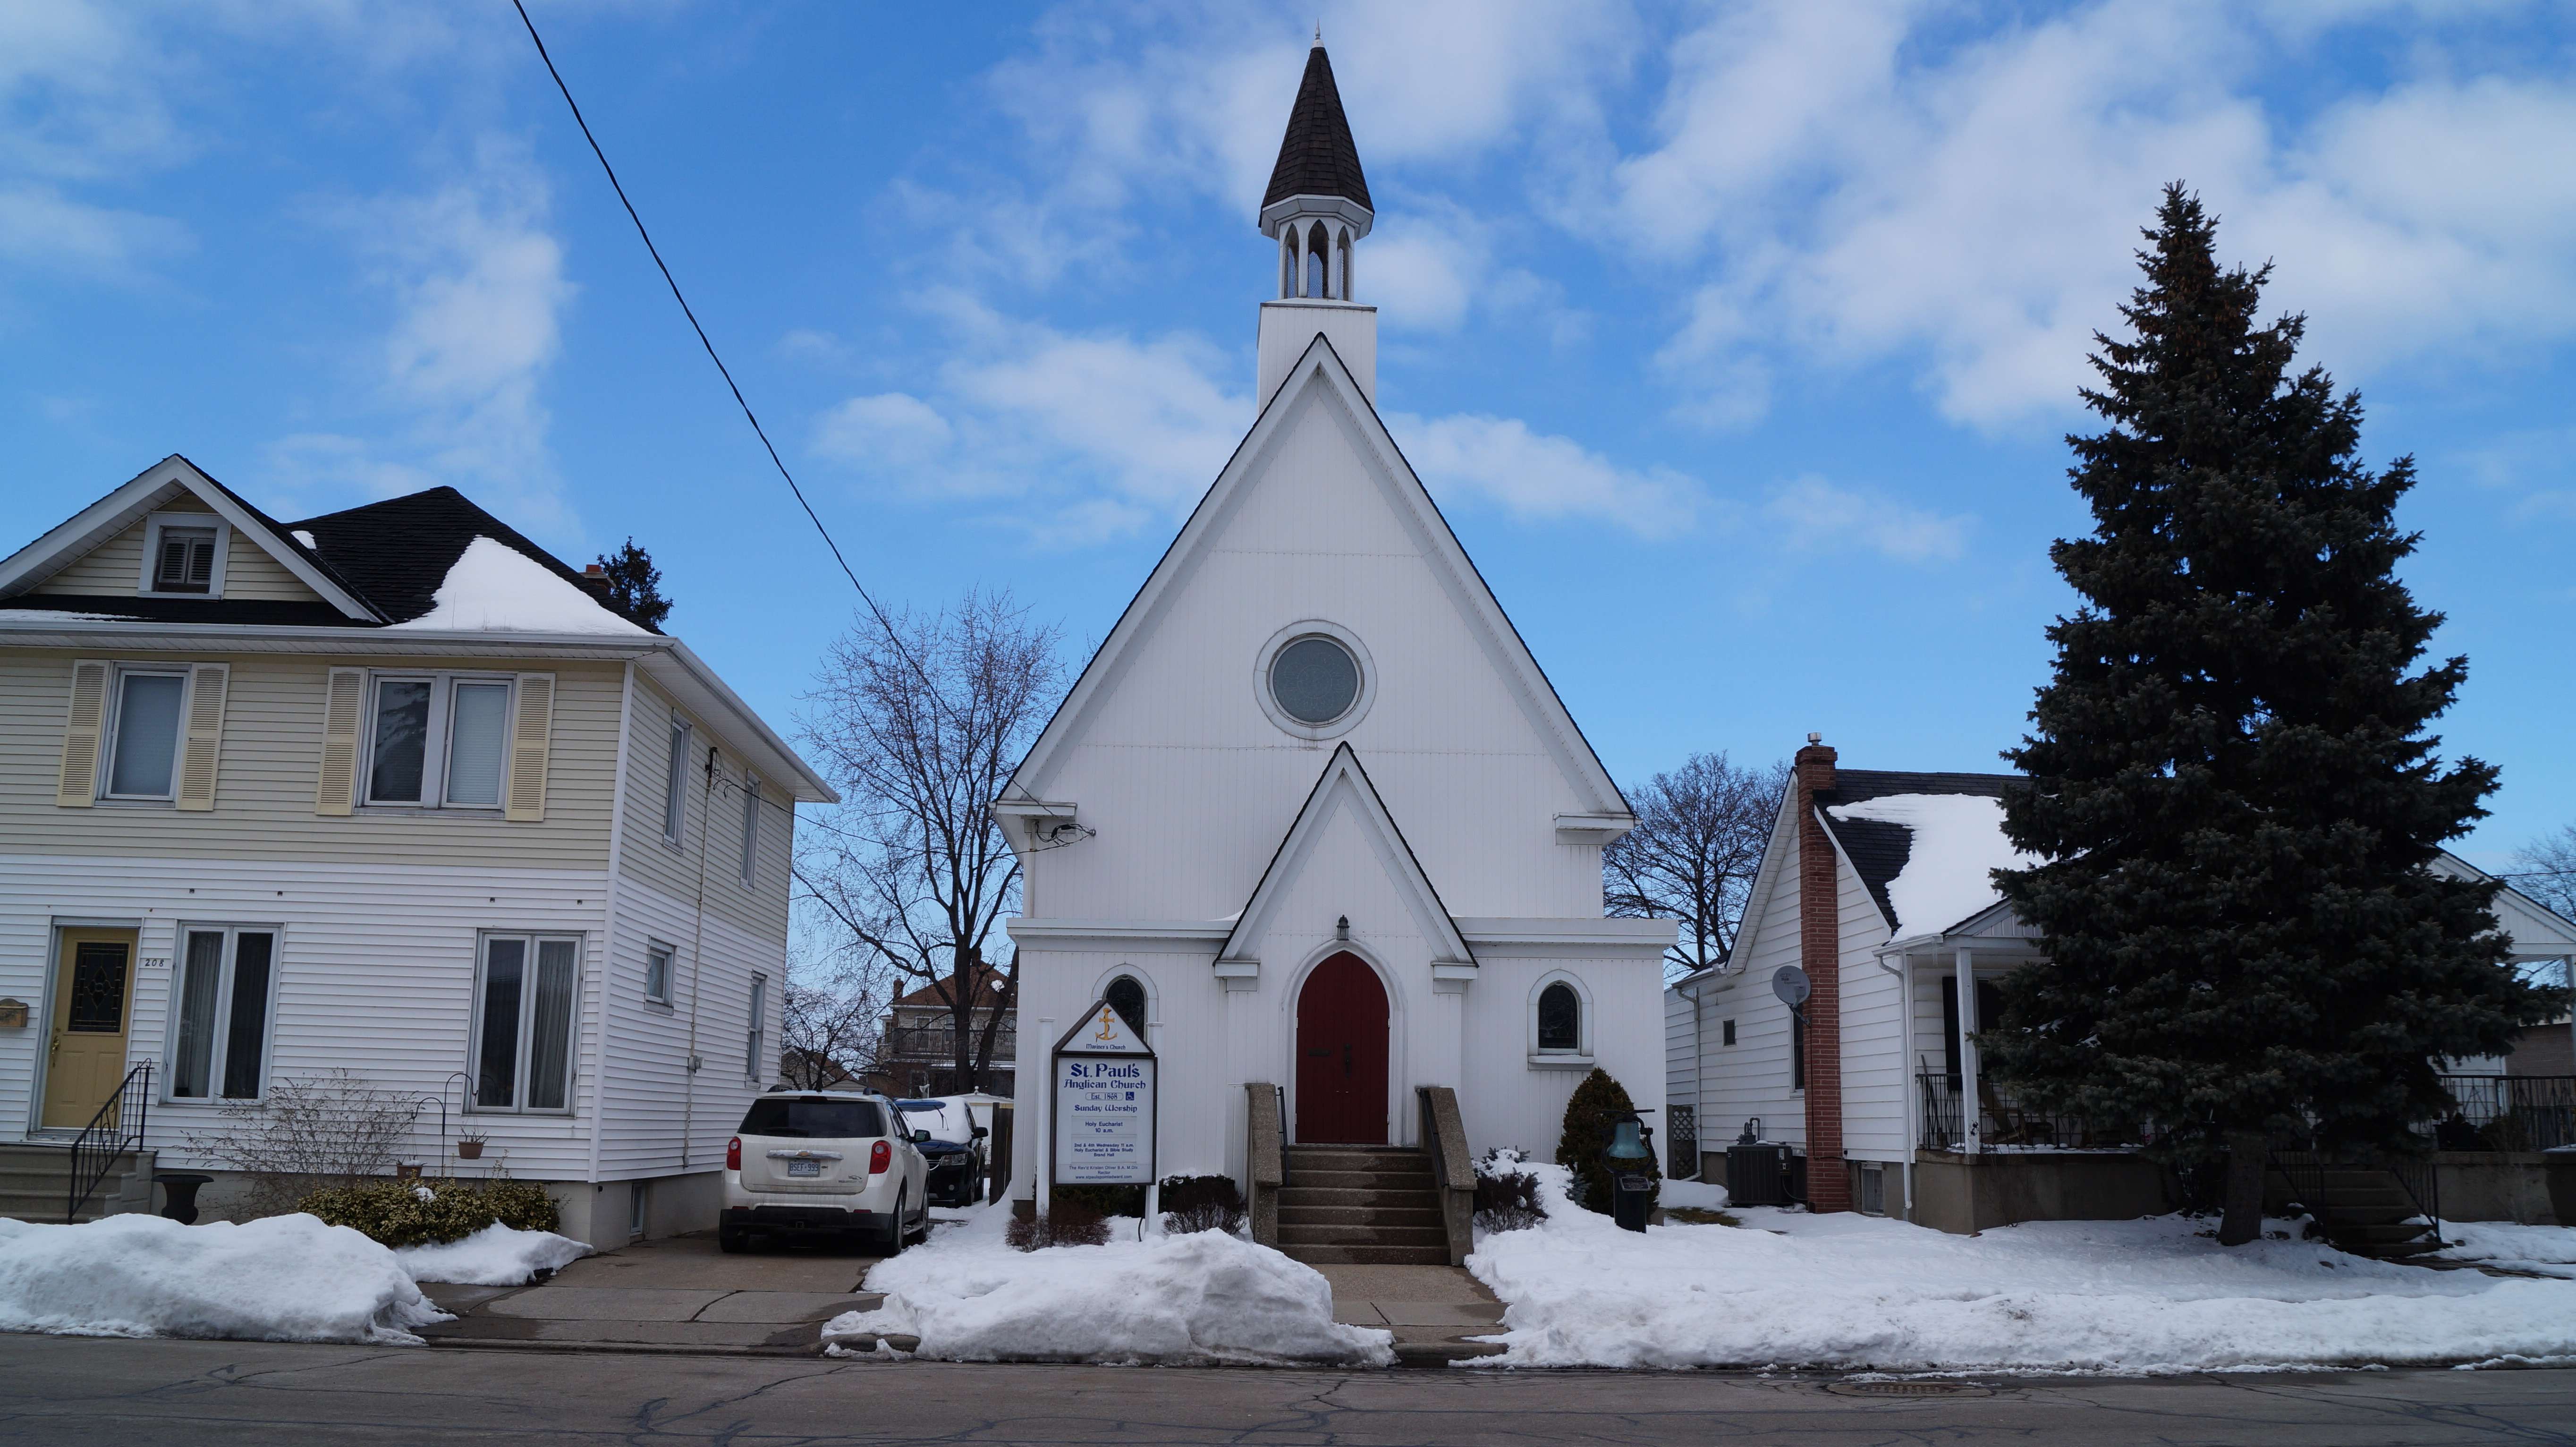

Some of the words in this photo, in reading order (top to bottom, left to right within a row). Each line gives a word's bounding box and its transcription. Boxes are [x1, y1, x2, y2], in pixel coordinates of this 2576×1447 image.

[145, 959, 164, 967] 208
[1070, 1063, 1093, 1078] St.
[1095, 1063, 1140, 1078] Paul's
[1064, 1079, 1107, 1090] Anglican
[1110, 1080, 1146, 1090] Church
[1105, 1105, 1137, 1113] Worship
